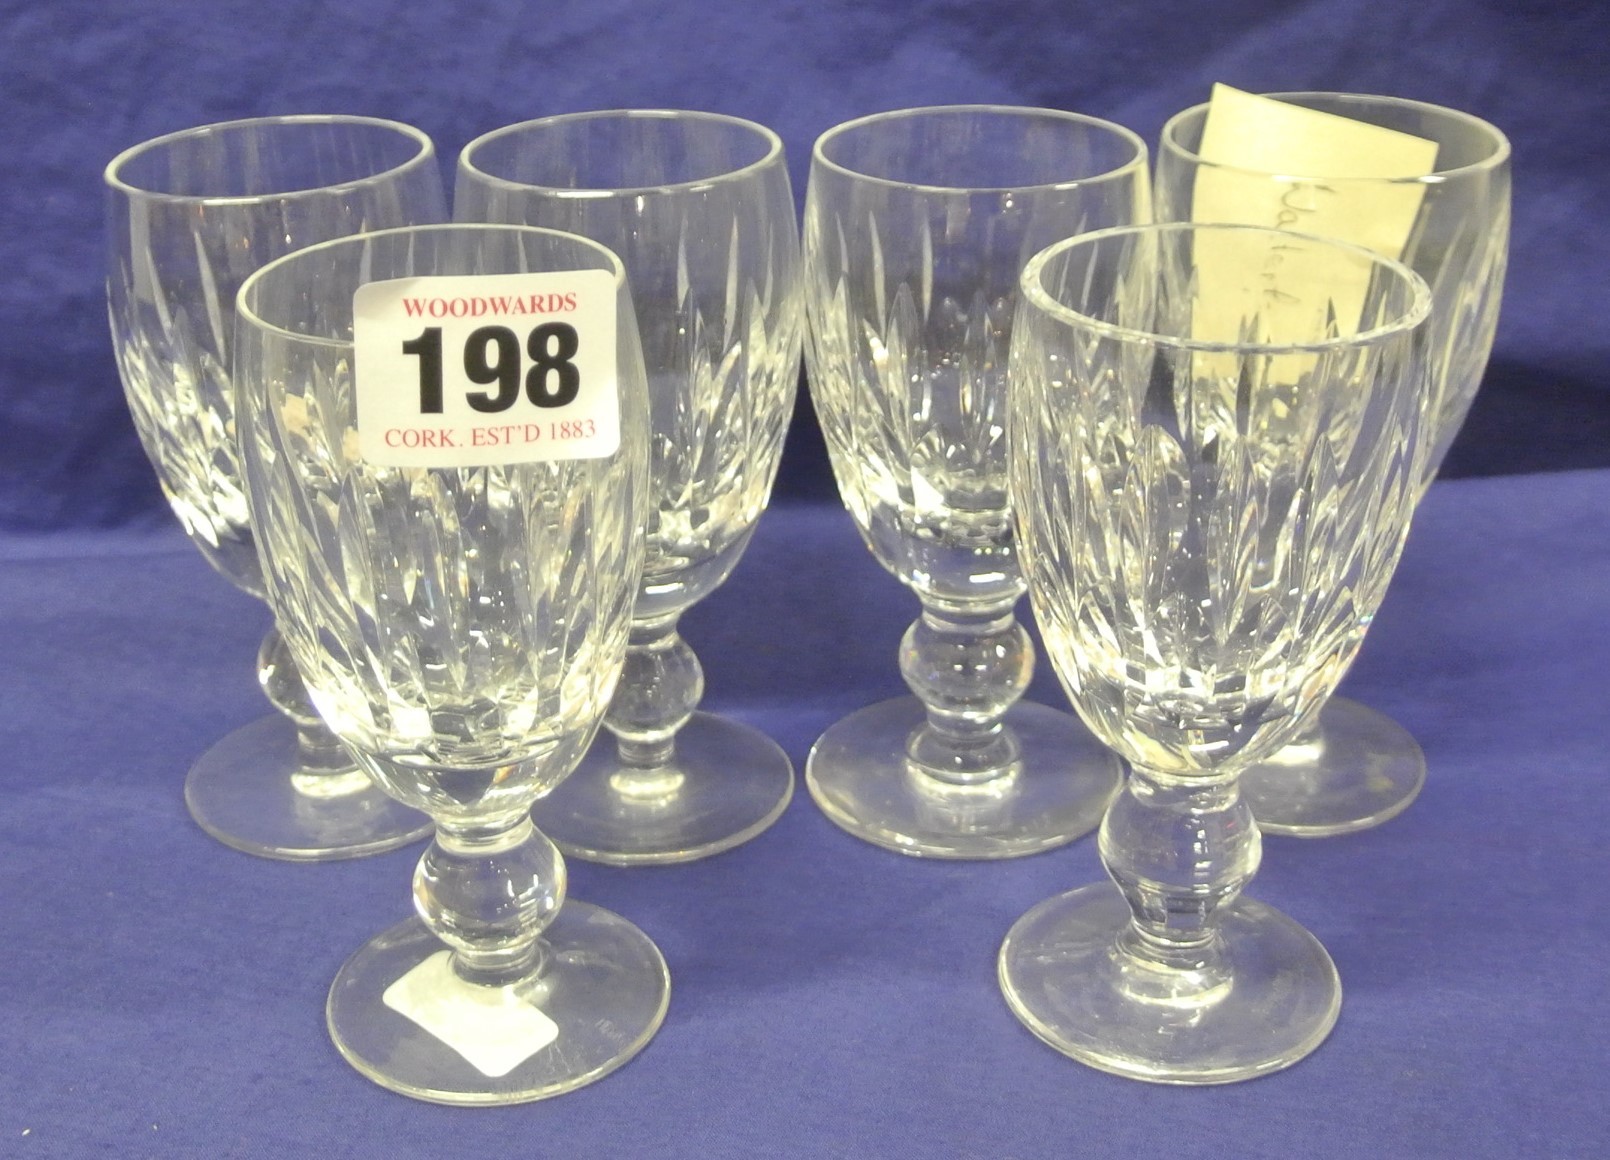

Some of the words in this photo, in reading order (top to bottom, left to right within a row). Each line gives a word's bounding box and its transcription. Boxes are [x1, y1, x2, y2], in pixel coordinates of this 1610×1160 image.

[402, 292, 577, 318] WOODWARDS
[402, 321, 580, 414] 198
[384, 428, 464, 448] CORK.
[471, 424, 541, 447] EST'D
[550, 419, 597, 442] 1883
